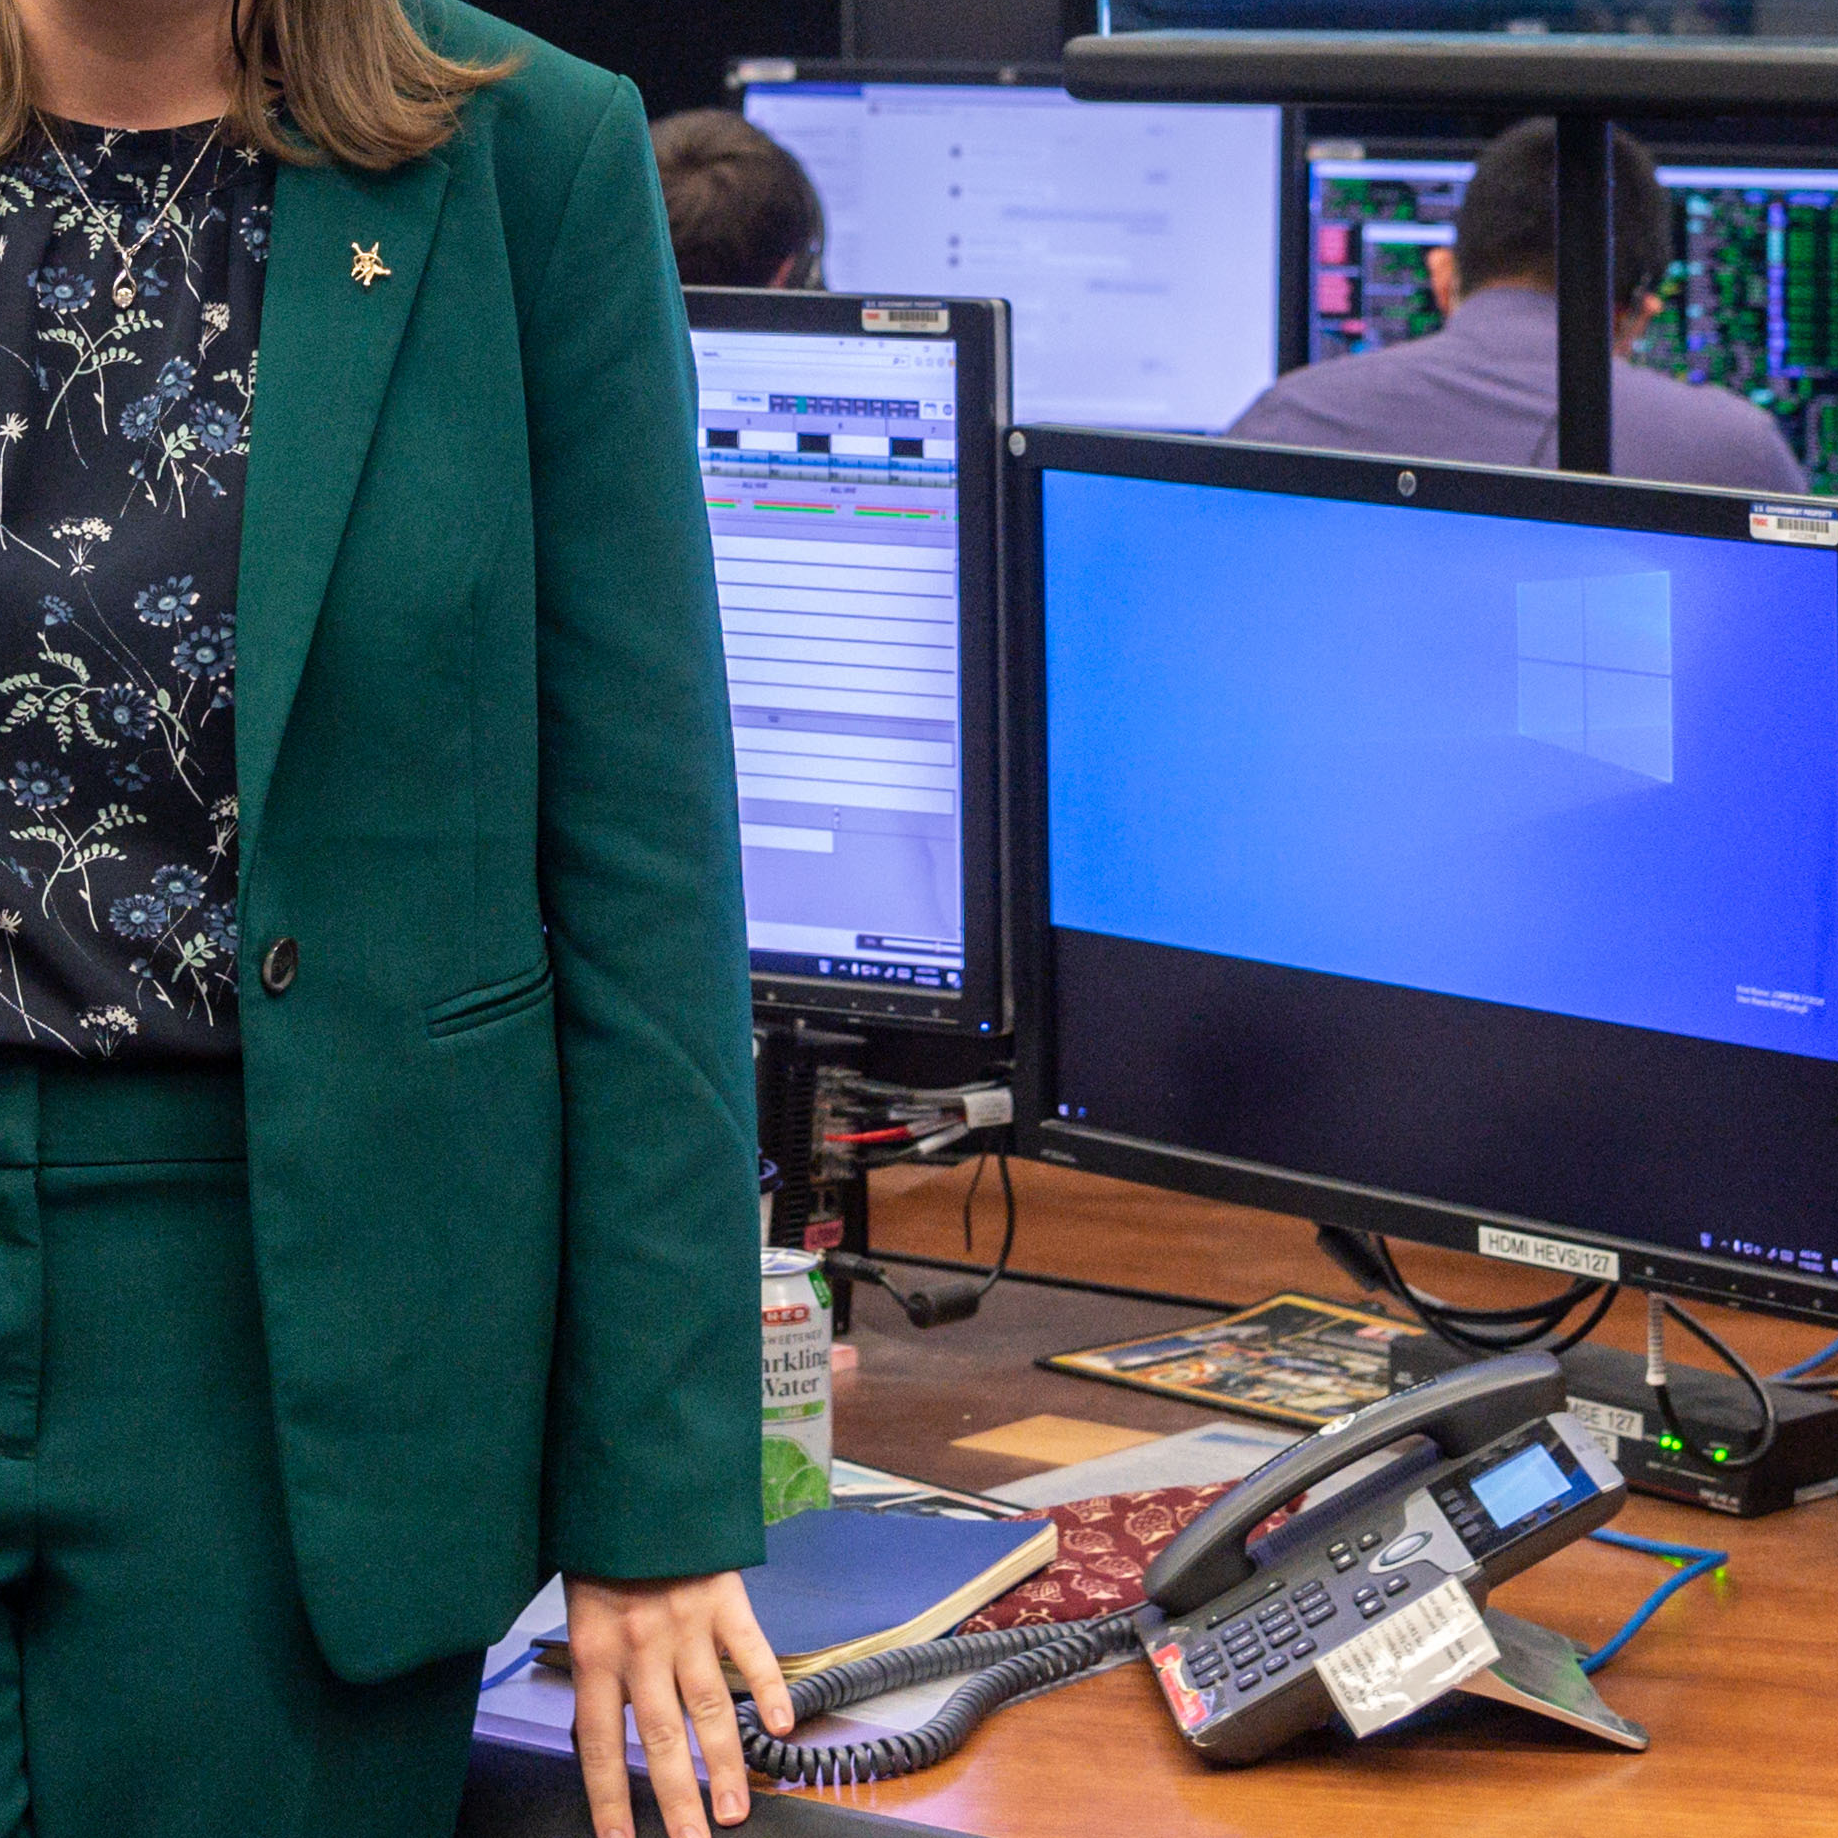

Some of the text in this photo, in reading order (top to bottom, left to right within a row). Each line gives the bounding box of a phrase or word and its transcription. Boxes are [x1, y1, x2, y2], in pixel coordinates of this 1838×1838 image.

[1488, 1232, 1610, 1275] HDMI HEVS/127
[1608, 1410, 1636, 1432] 127
